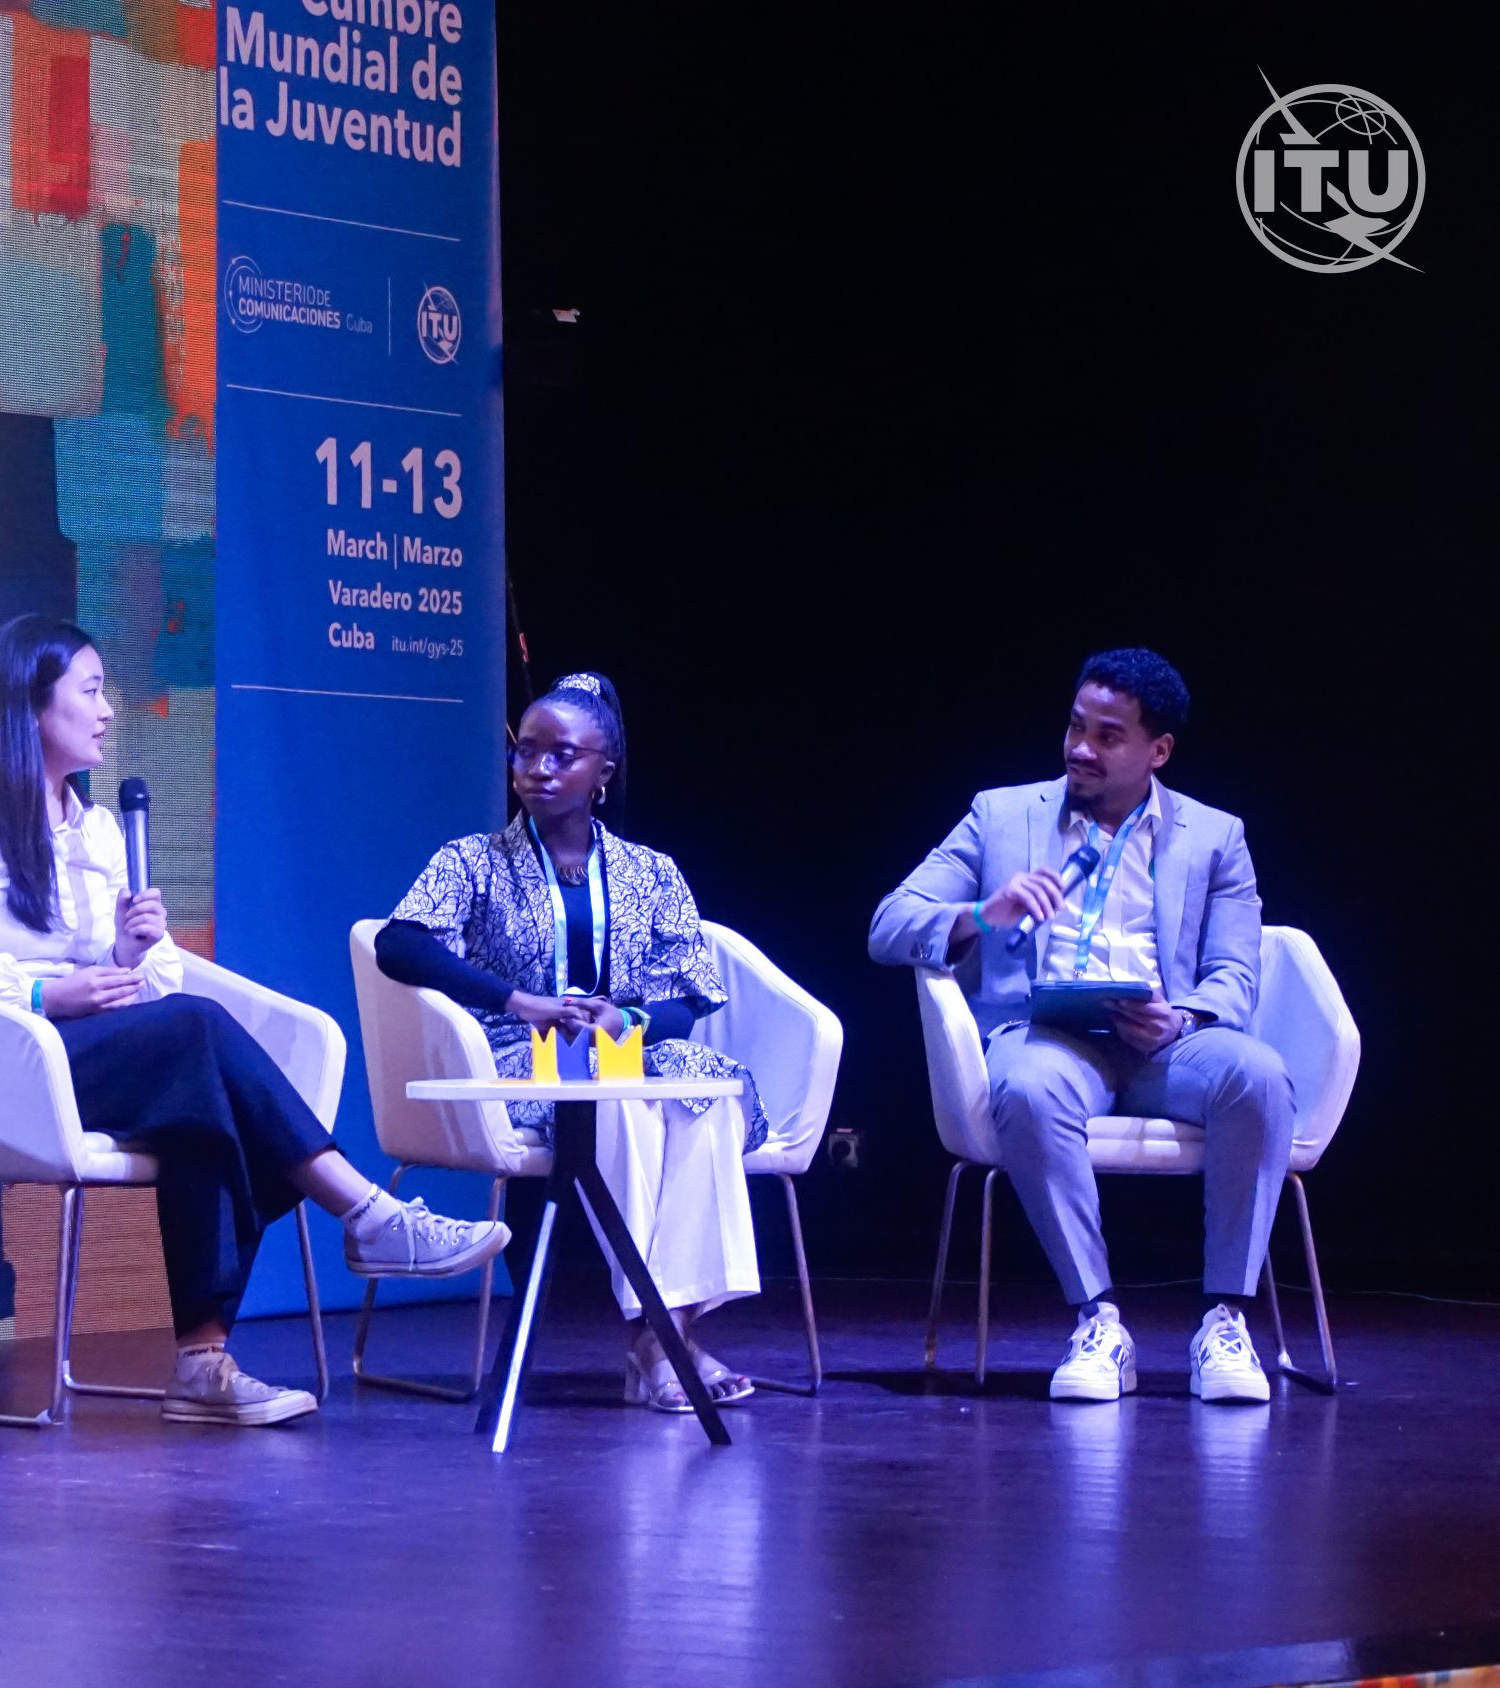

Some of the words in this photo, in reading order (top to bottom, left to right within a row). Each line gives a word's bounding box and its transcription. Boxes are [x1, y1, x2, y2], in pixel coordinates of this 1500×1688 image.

[303, 0, 463, 44] umbre
[226, 6, 398, 94] Mundial
[412, 43, 463, 106] de
[220, 66, 255, 131] la
[265, 81, 461, 168] Juventud
[238, 274, 316, 306] MINISTERIO
[238, 297, 341, 329] COMUNICACIONES
[346, 312, 373, 334] Cuba
[421, 311, 459, 342] ITU
[315, 437, 463, 519] 11-13
[327, 528, 388, 561] March
[403, 535, 463, 568] Marzo
[328, 579, 412, 612] Varadero
[418, 586, 463, 616] 2025
[328, 621, 375, 651] Cuba
[391, 634, 464, 660] itu.int/gys-25
